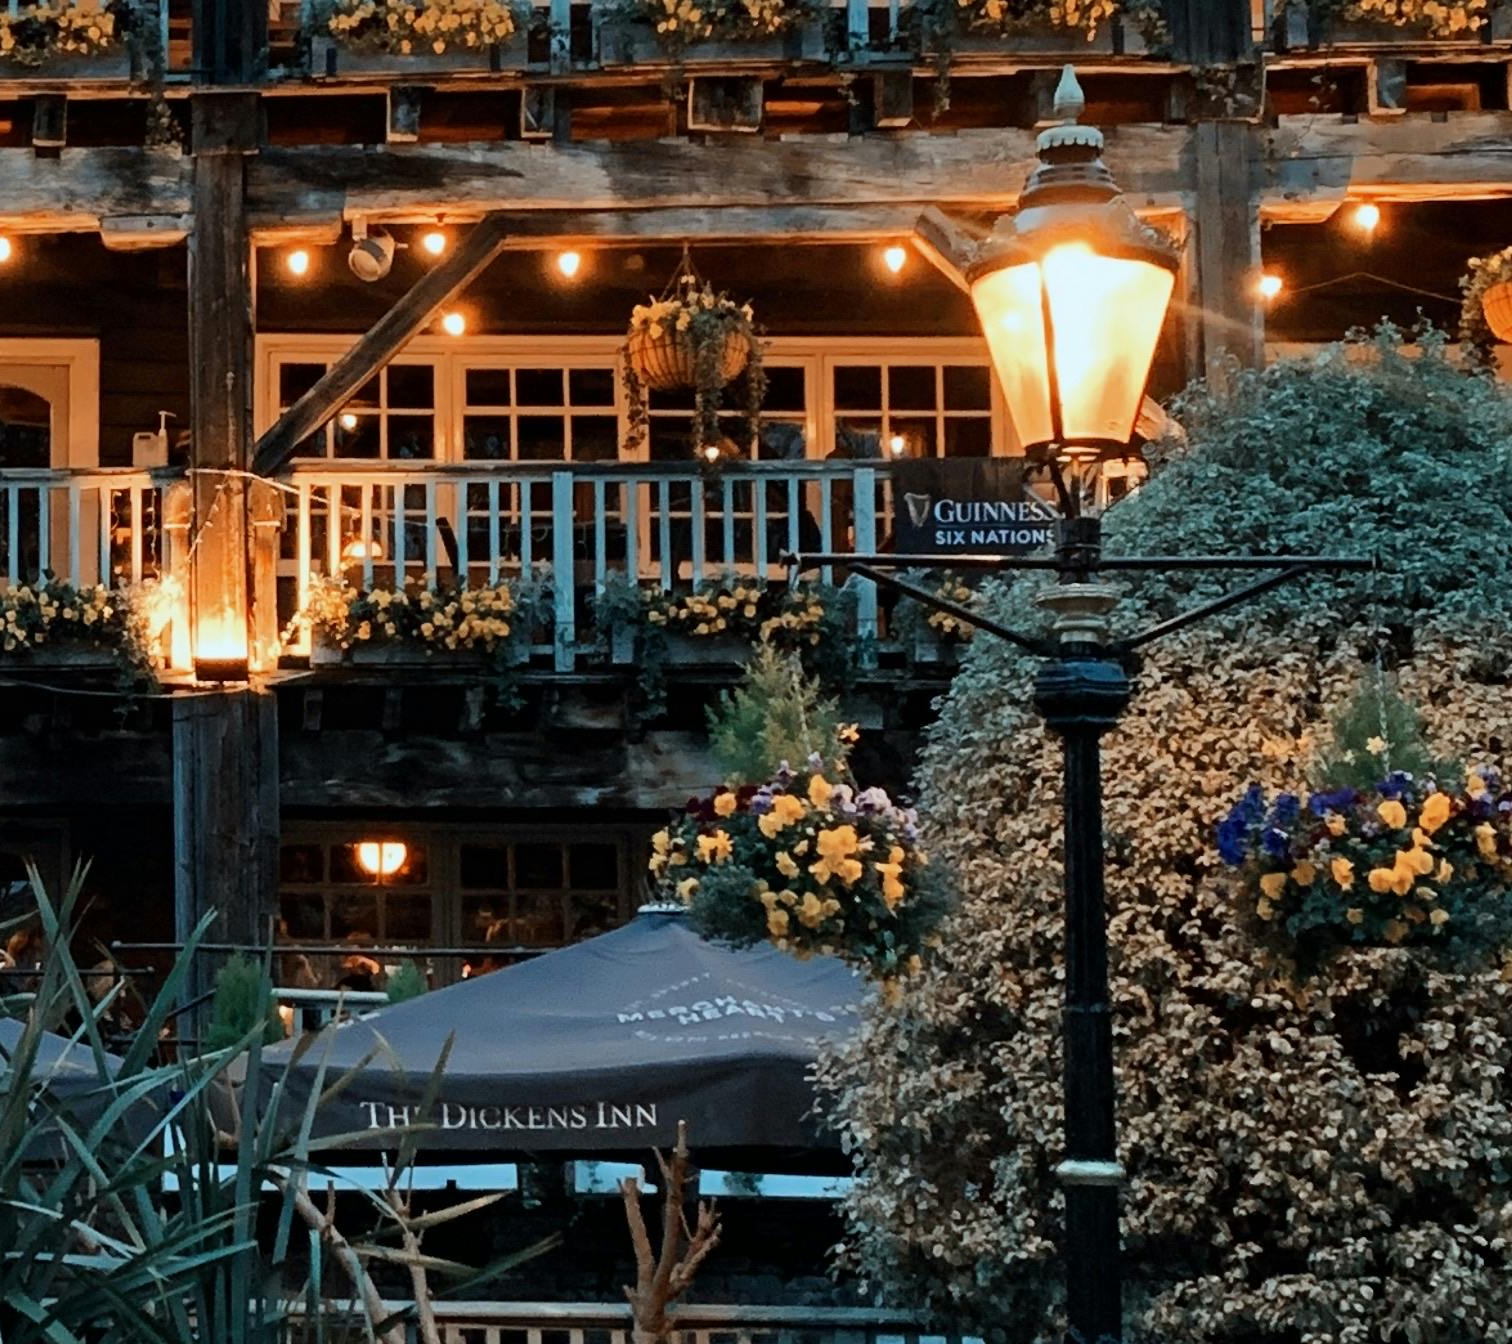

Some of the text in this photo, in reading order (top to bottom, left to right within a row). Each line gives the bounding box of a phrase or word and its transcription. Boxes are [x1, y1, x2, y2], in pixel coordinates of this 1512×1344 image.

[935, 530, 966, 545] SIX
[360, 1101, 657, 1130] TH DICKENS INN
